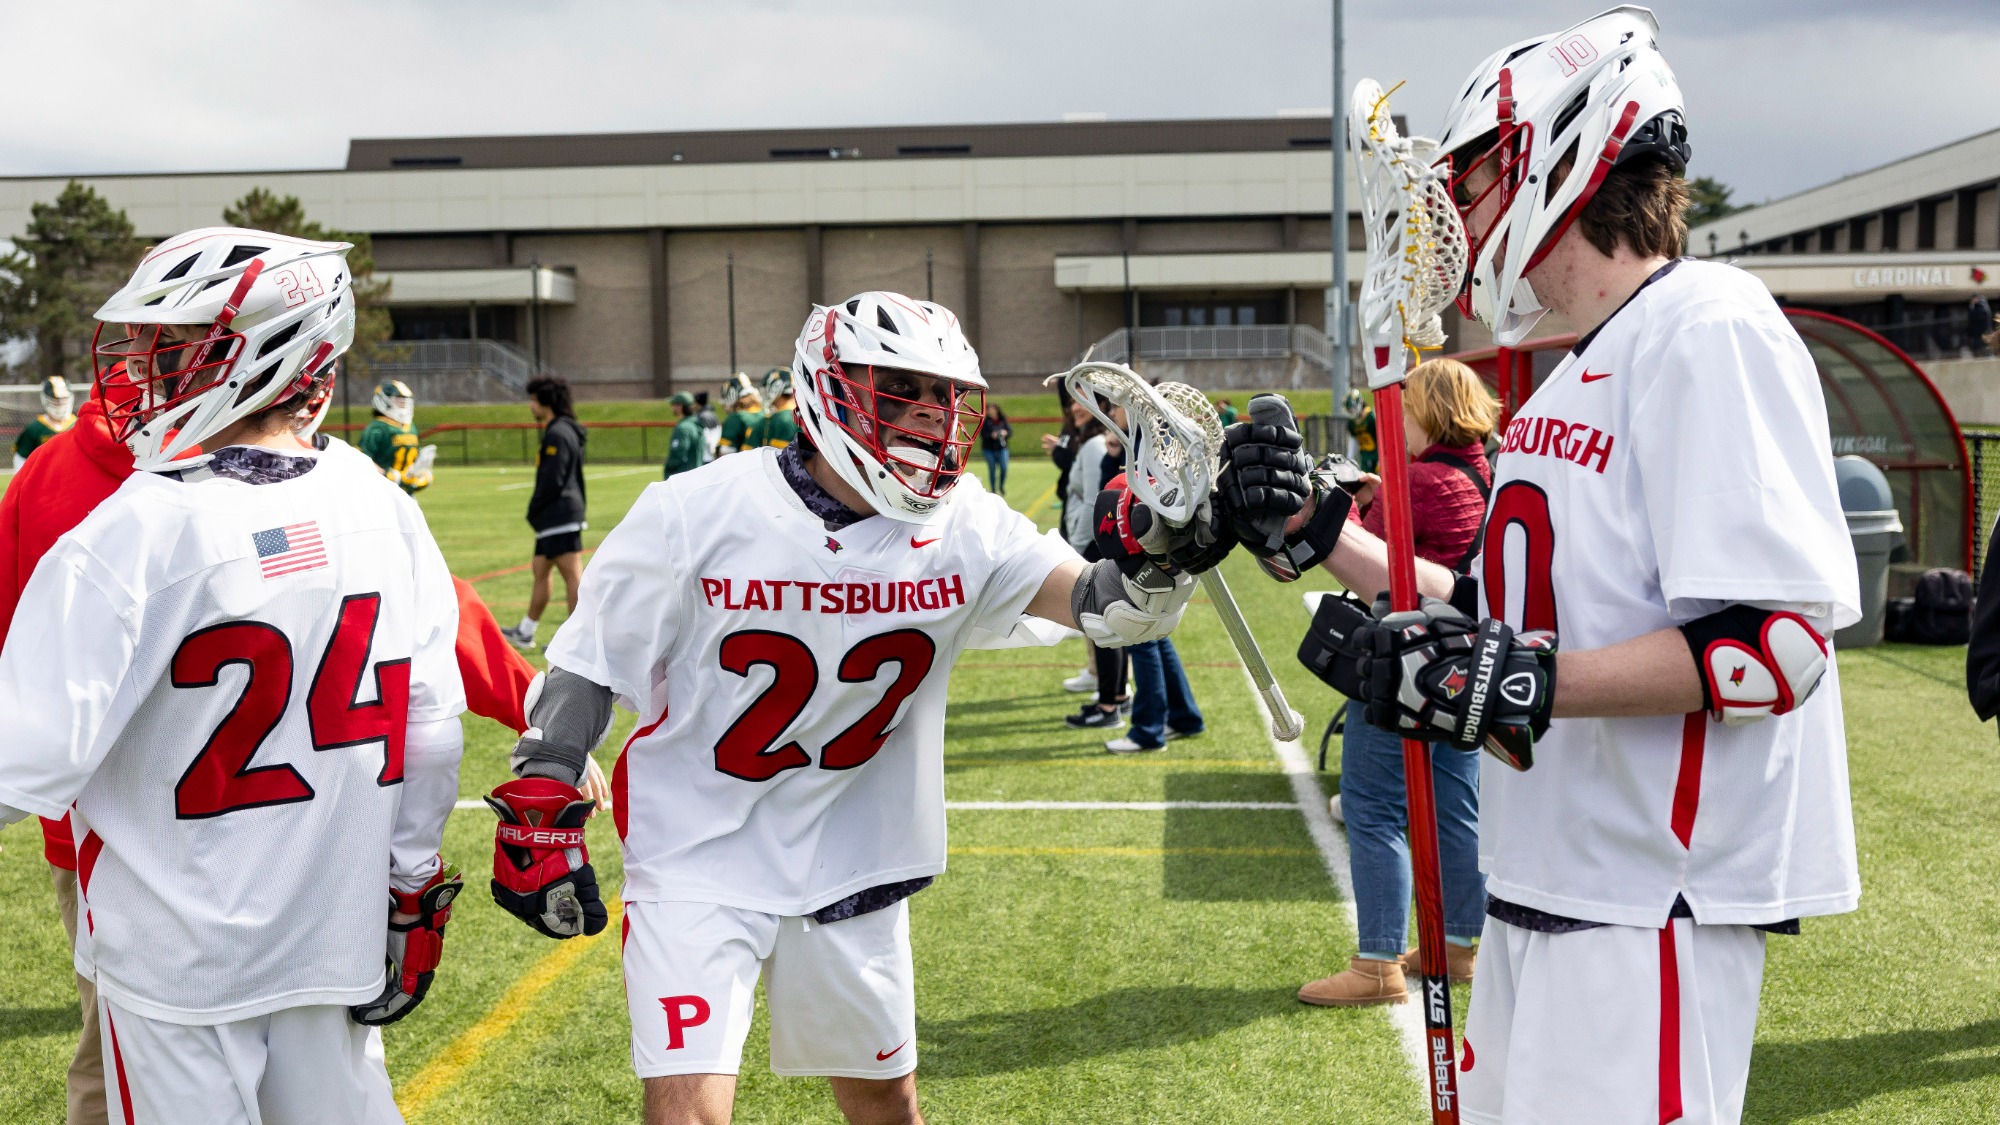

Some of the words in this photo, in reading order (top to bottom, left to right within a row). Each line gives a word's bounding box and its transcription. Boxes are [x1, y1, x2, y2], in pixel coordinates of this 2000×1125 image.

[1548, 34, 1599, 78] 10
[274, 261, 325, 309] 24
[1853, 267, 1954, 288] CARDINAL
[700, 574, 967, 615] PLATTSBURGH
[171, 591, 412, 820] 24
[713, 628, 937, 783] 22
[1460, 638, 1500, 744] PLATTSBURGH
[657, 994, 711, 1051] P
[1428, 979, 1446, 1025] STX
[1432, 1035, 1457, 1112] SABRE
